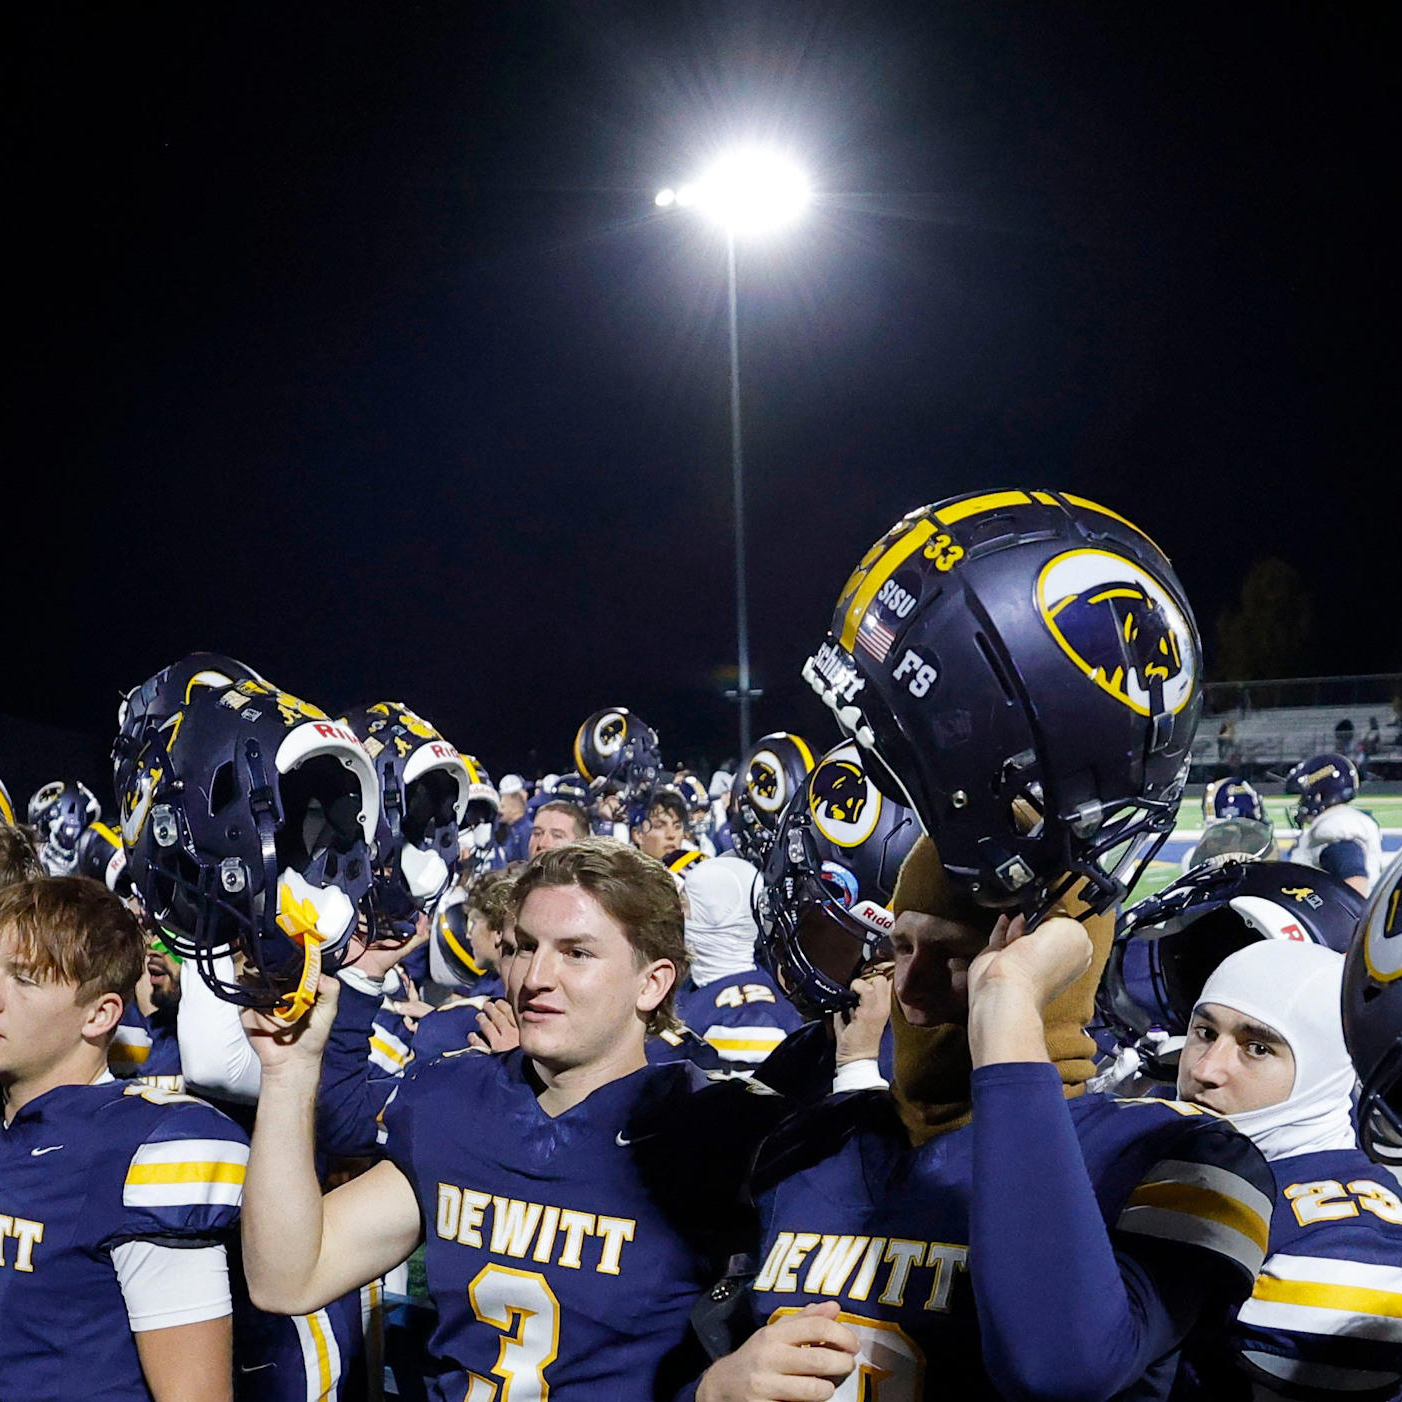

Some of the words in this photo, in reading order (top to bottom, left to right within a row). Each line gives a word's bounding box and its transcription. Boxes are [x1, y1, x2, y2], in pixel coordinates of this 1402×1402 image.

[923, 534, 964, 571] 33
[878, 579, 916, 618] SISU
[892, 649, 937, 697] FS
[862, 907, 893, 929] Ridd
[715, 984, 776, 1008] 42
[436, 1181, 637, 1275] DEWITT
[752, 1231, 969, 1313] DEWITT
